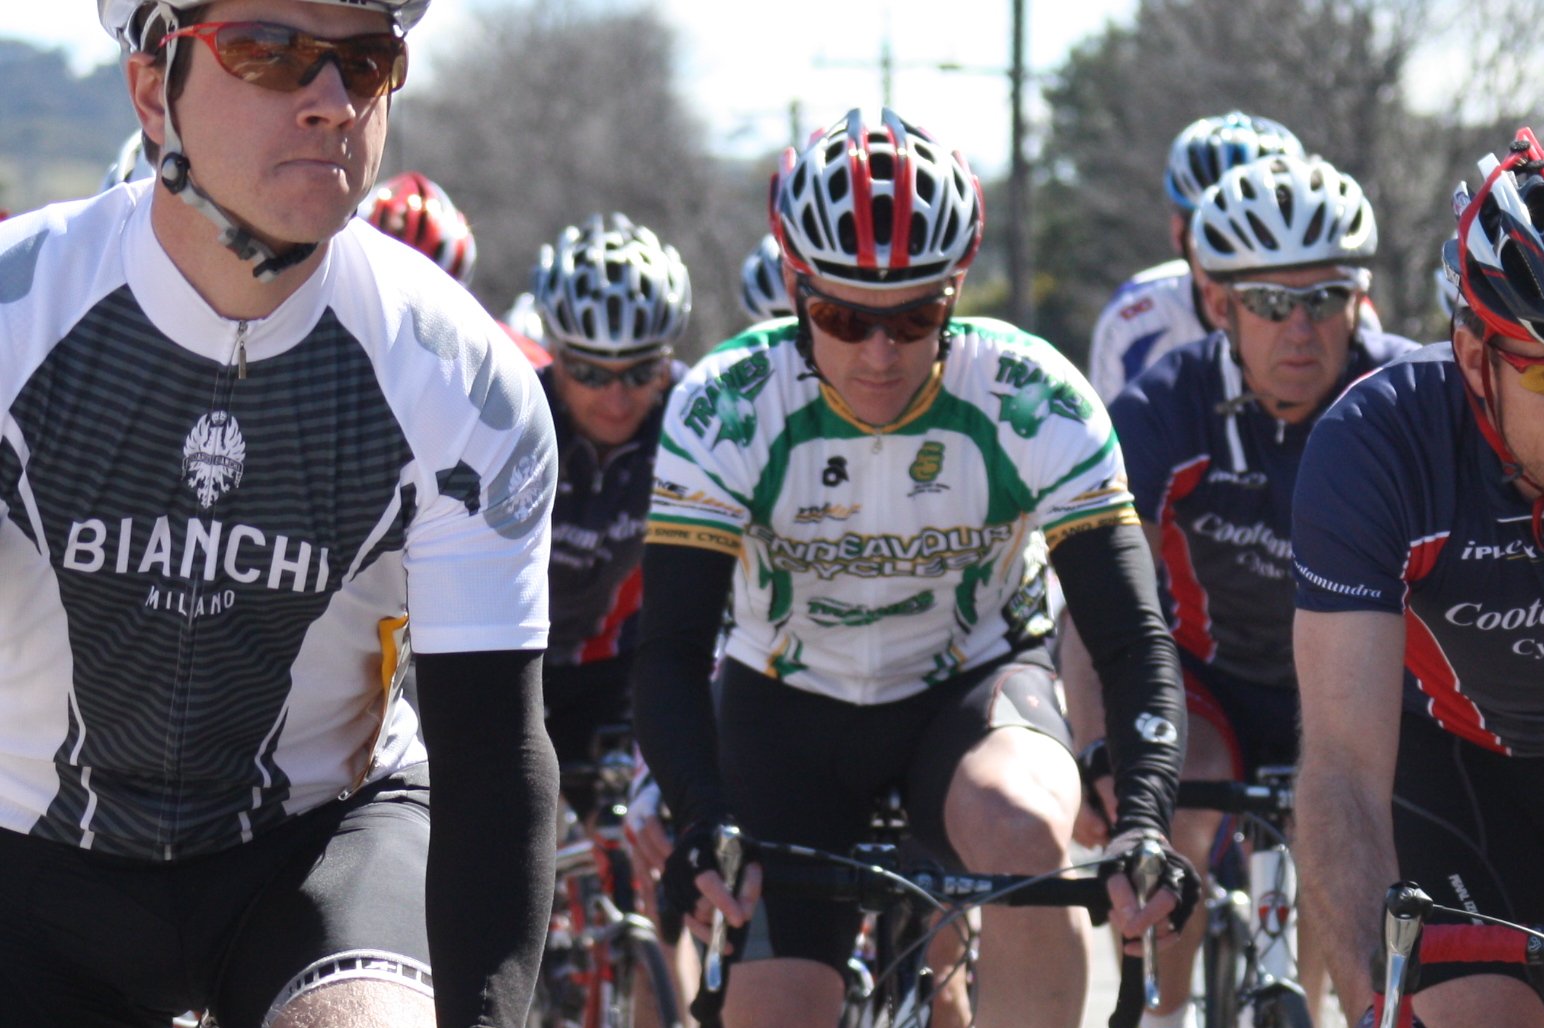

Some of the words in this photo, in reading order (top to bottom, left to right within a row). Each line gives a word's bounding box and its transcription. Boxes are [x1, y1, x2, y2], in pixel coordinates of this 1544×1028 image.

[63, 515, 329, 593] BIANCHI
[744, 523, 1013, 561] ENDEAVOUR
[772, 550, 983, 581] CYCLES
[145, 585, 236, 617] MILANO
